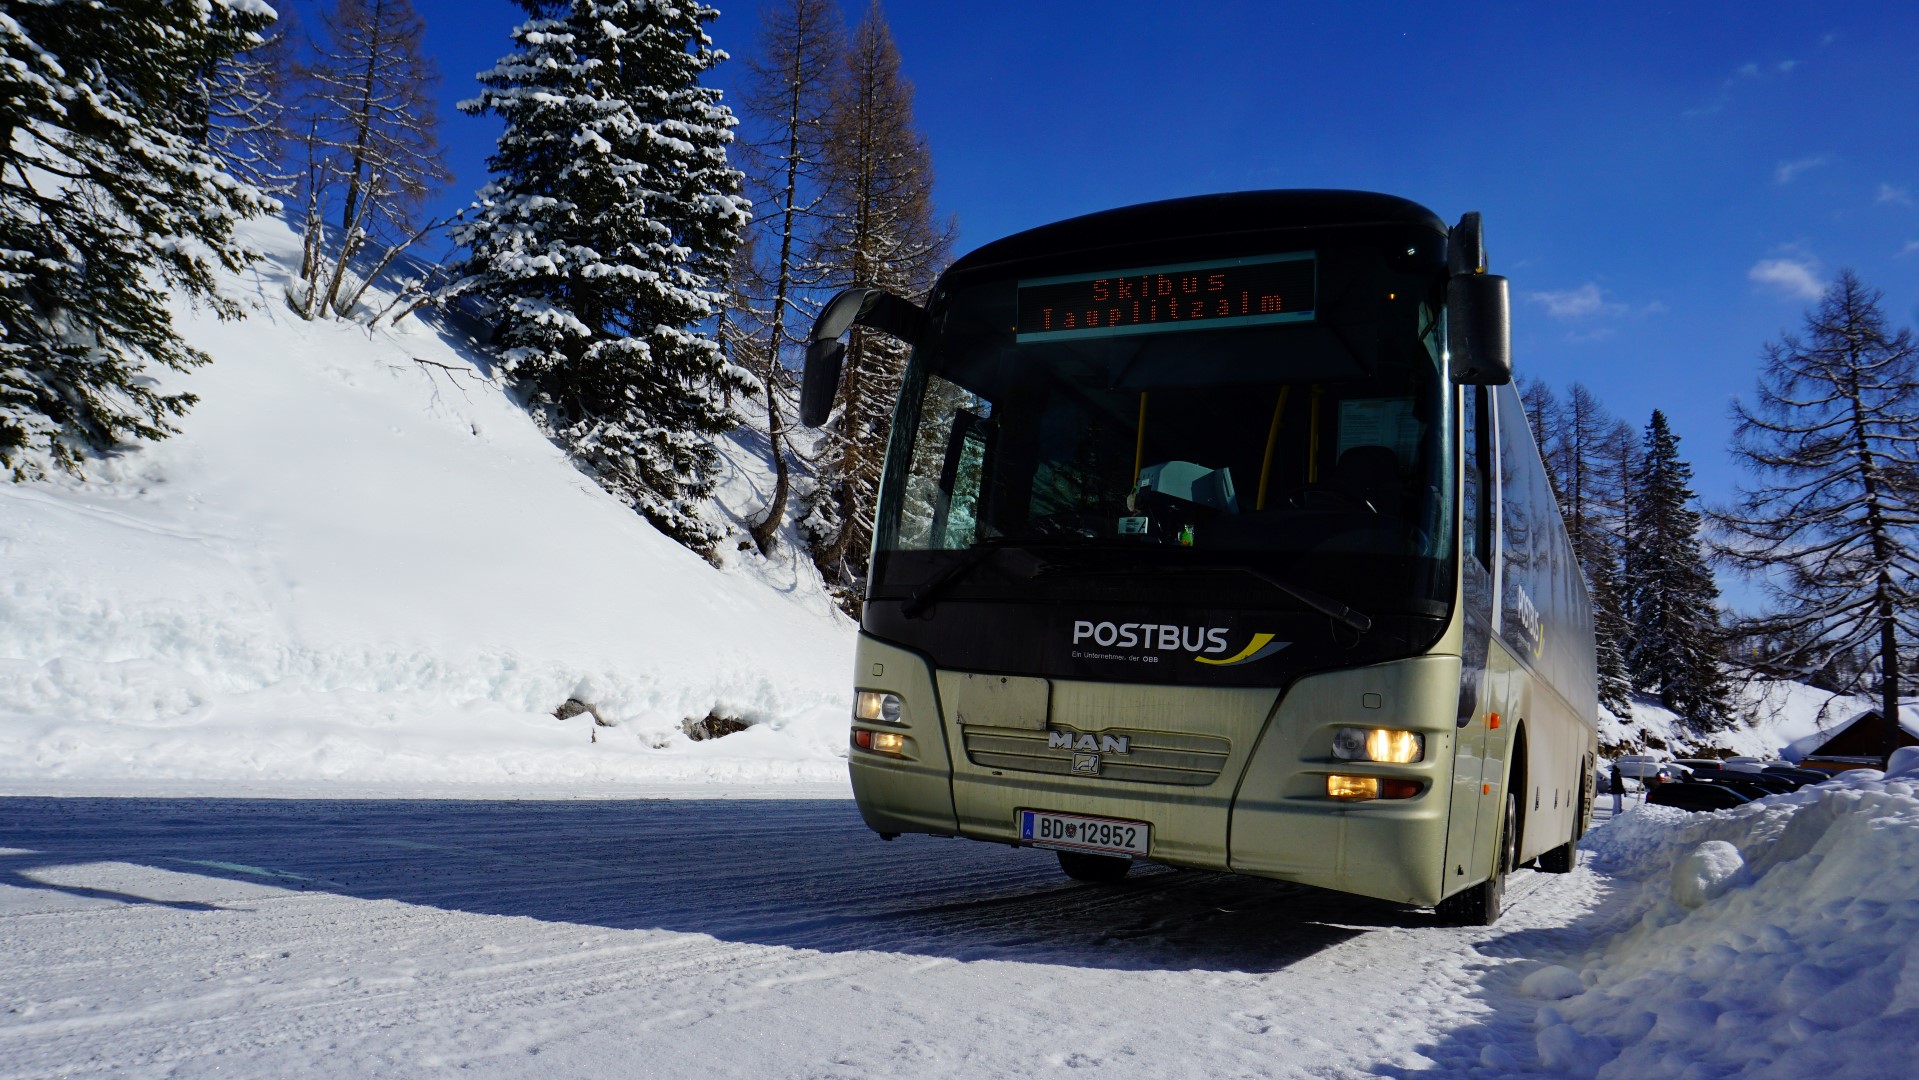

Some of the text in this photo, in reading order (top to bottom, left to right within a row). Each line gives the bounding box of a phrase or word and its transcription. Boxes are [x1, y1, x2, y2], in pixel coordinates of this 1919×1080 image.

[1093, 274, 1225, 301] Skibus
[1043, 291, 1282, 330] Tauplitzalm
[1072, 620, 1229, 653] POSTBUS
[1071, 650, 1082, 658] Ein
[1128, 654, 1140, 662] der
[1048, 731, 1130, 755] MAN
[1025, 828, 1031, 836] A
[1040, 817, 1136, 849] BD 12952
